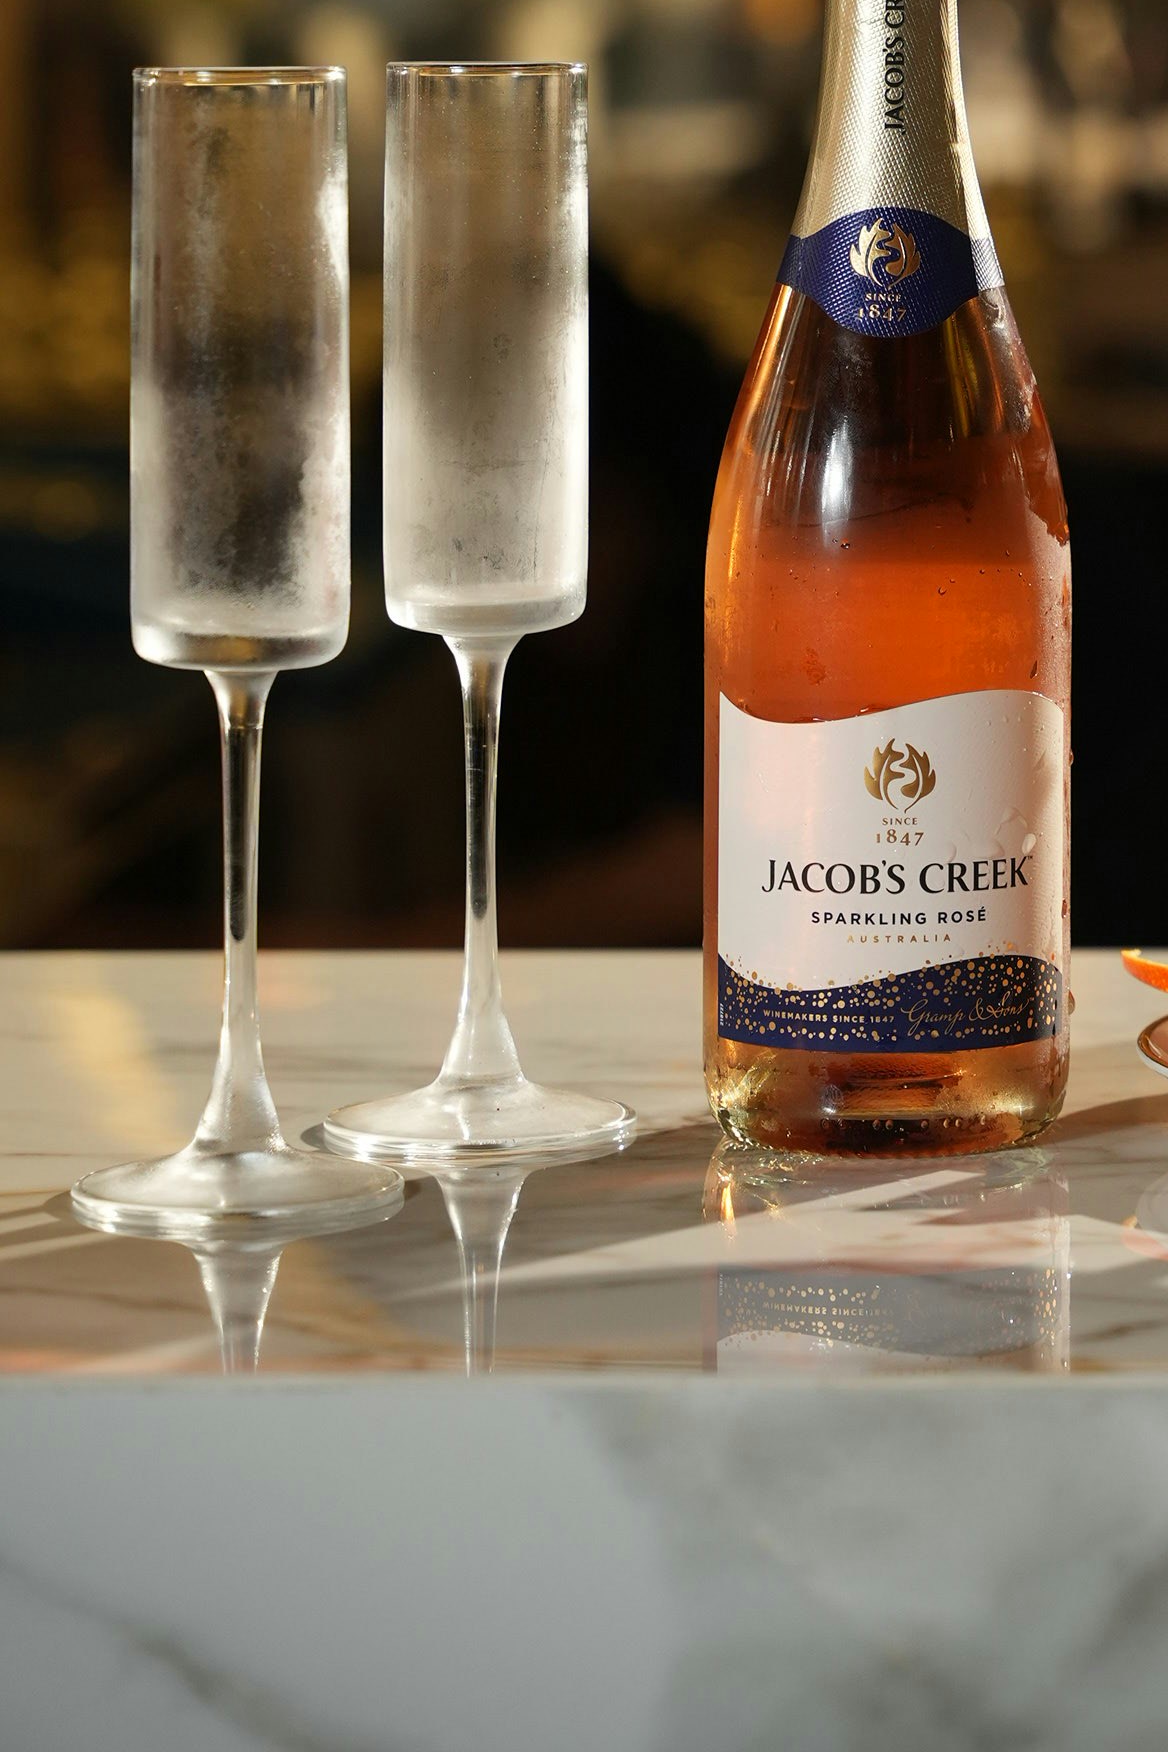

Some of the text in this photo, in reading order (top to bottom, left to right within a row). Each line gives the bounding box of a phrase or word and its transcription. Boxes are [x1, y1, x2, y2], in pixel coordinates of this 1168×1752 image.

[883, 36, 906, 135] JACOB'S
[865, 293, 901, 302] SINCE
[858, 304, 906, 322] 1847
[882, 817, 918, 826] SINCE
[876, 829, 924, 846] 1847
[761, 859, 906, 895] JACOB'S
[811, 906, 986, 925] SPARKLING ROSÉ
[847, 933, 951, 943] AUSTRALIA
[763, 1009, 895, 1023] WINEMAKERS SINCE 1847
[901, 999, 965, 1036] Gramp
